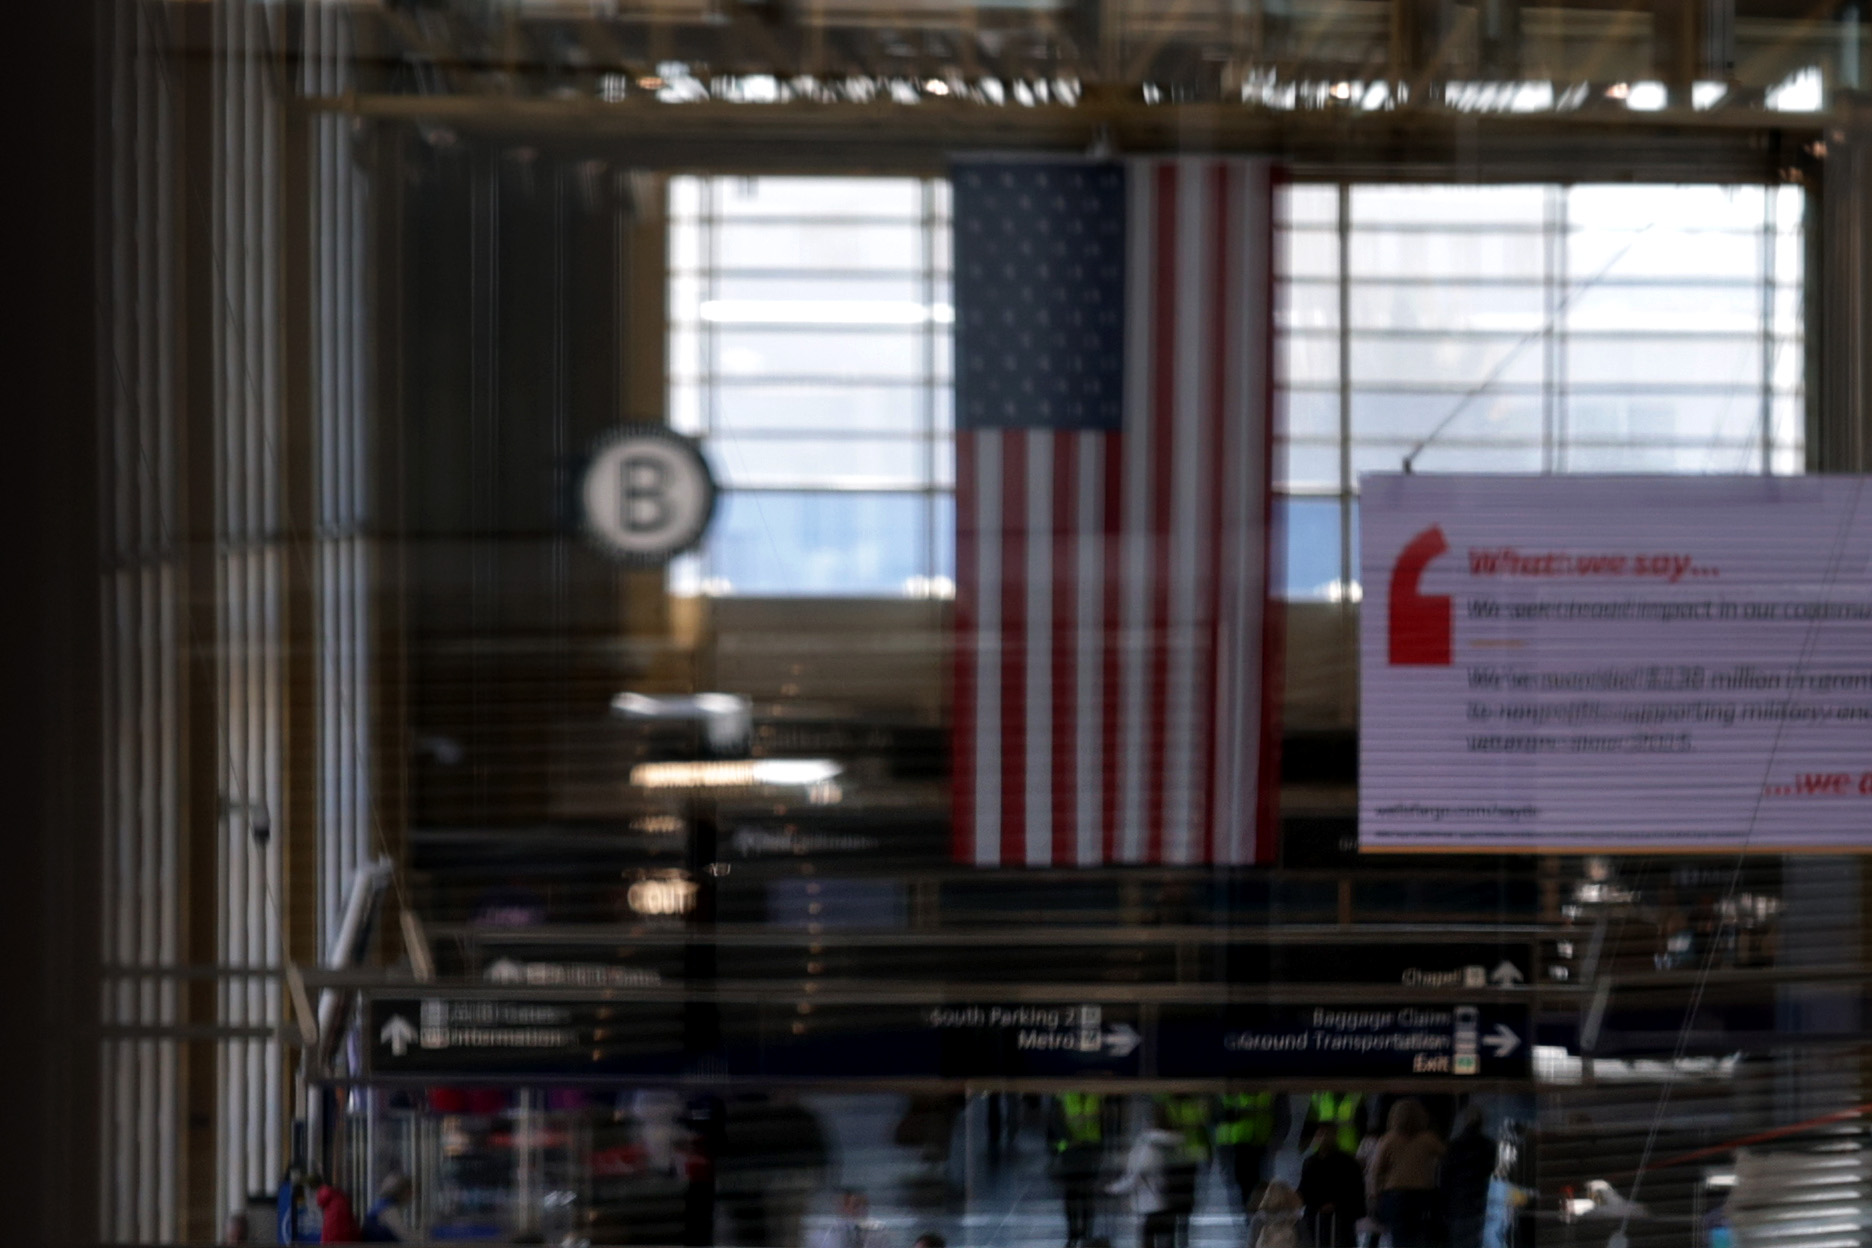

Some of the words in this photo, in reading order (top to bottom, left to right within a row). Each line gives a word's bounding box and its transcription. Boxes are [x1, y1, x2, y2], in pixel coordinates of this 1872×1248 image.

[620, 457, 675, 533] B
[1575, 554, 1628, 576] we
[1633, 554, 1721, 583] say...
[1743, 601, 1777, 620] our
[988, 1004, 1059, 1031] Parking
[1311, 1006, 1396, 1032] Baggage
[1016, 1029, 1076, 1051] Metro
[1228, 1029, 1310, 1052] Ground
[1312, 1029, 1453, 1055] Transportation
